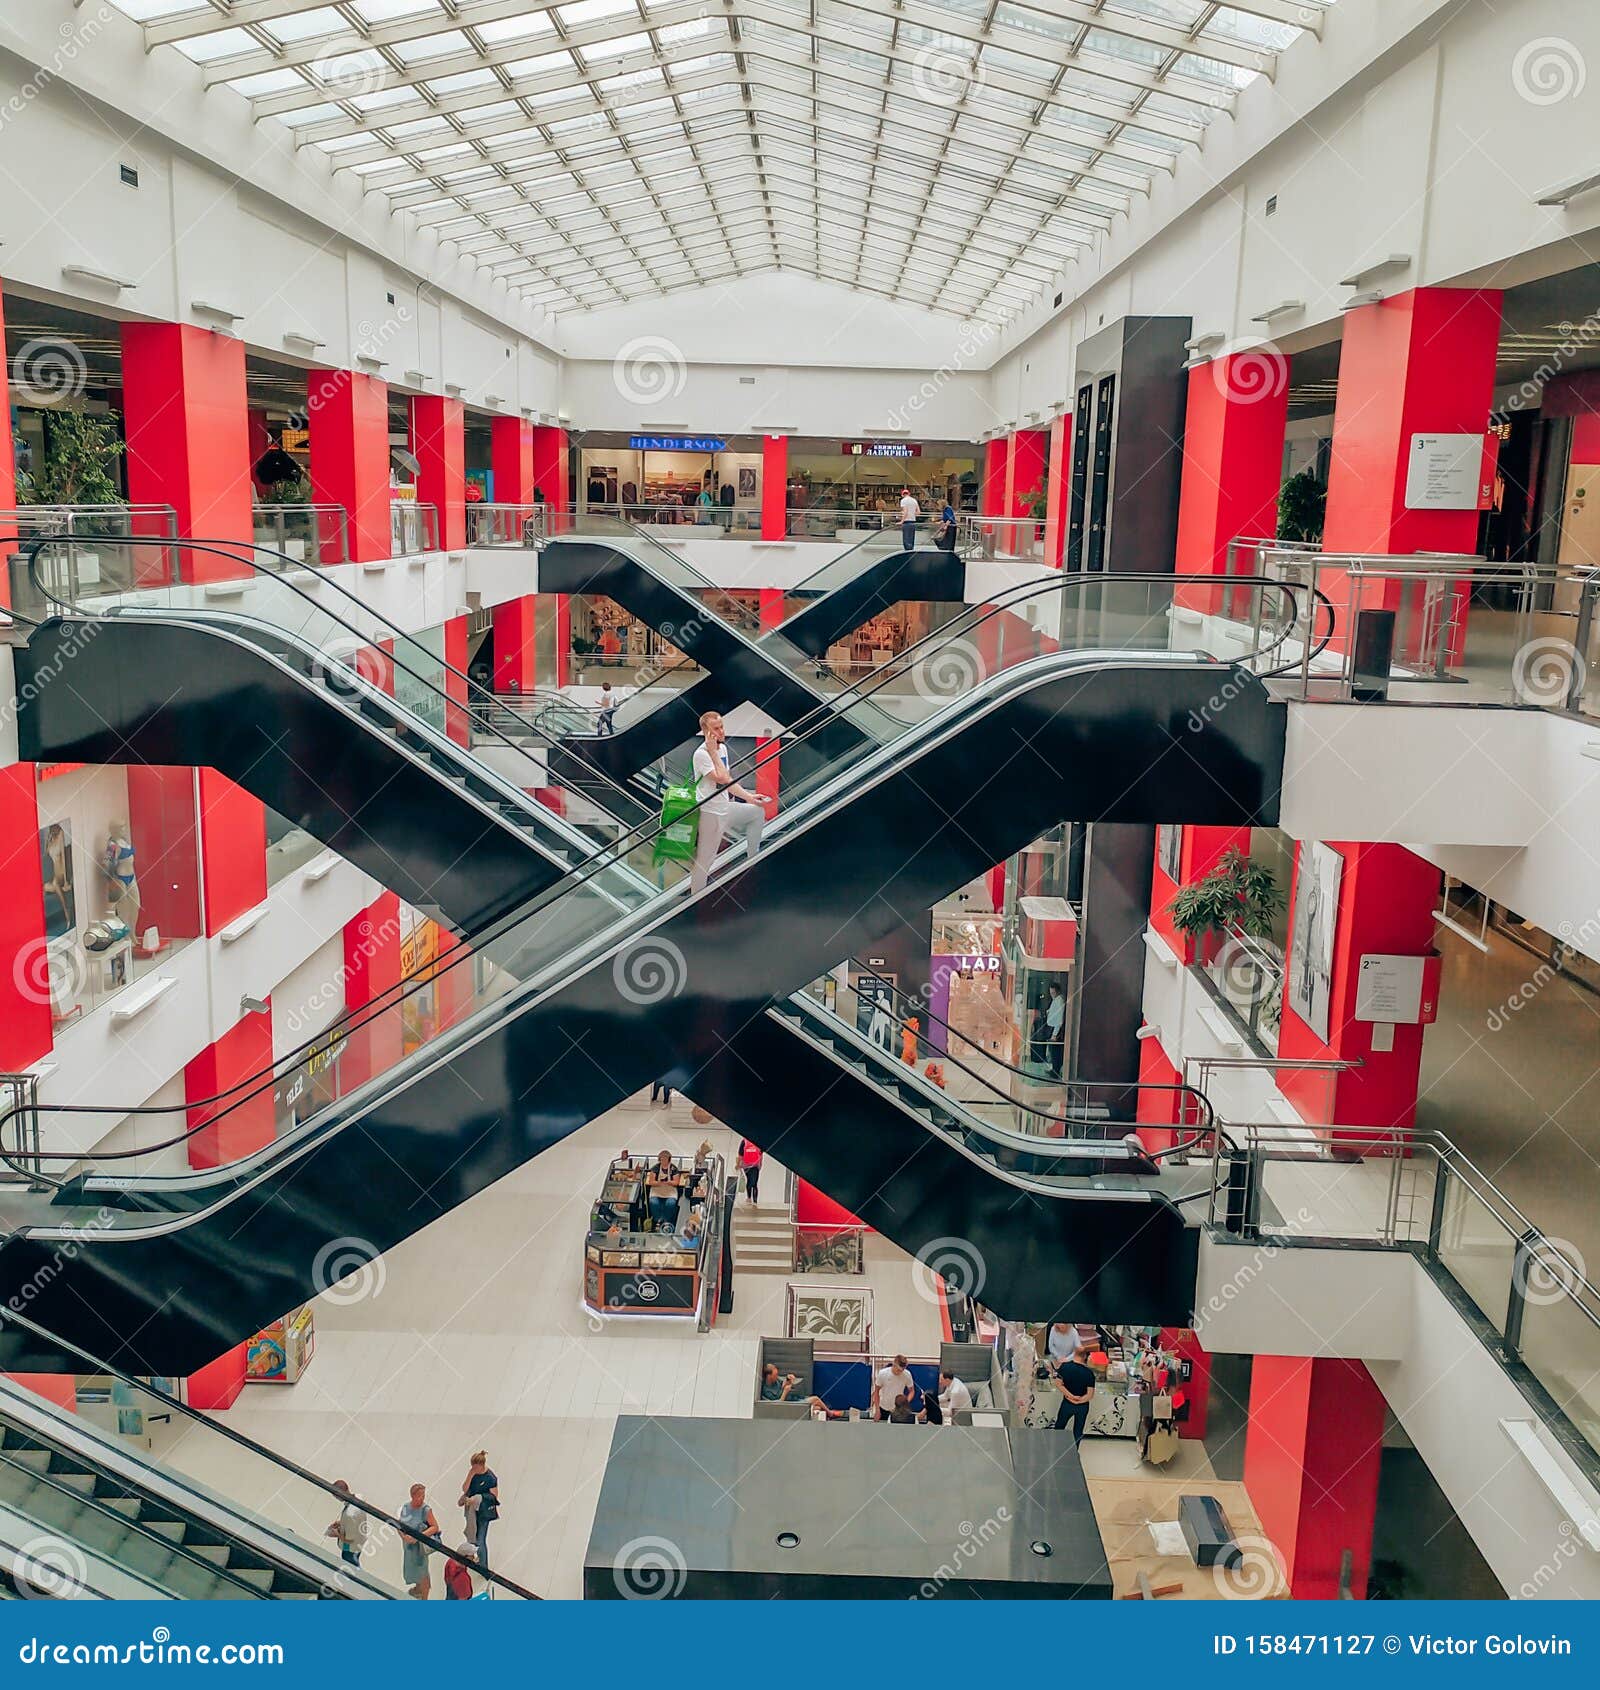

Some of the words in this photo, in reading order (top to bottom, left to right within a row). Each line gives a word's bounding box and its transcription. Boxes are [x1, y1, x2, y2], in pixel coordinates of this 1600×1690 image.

[630, 437, 727, 450] HENDERSON
[1417, 439, 1425, 450] 3
[866, 448, 914, 457] ЛАБИРИНТ
[962, 957, 999, 969] LAD
[1363, 960, 1370, 970] 2
